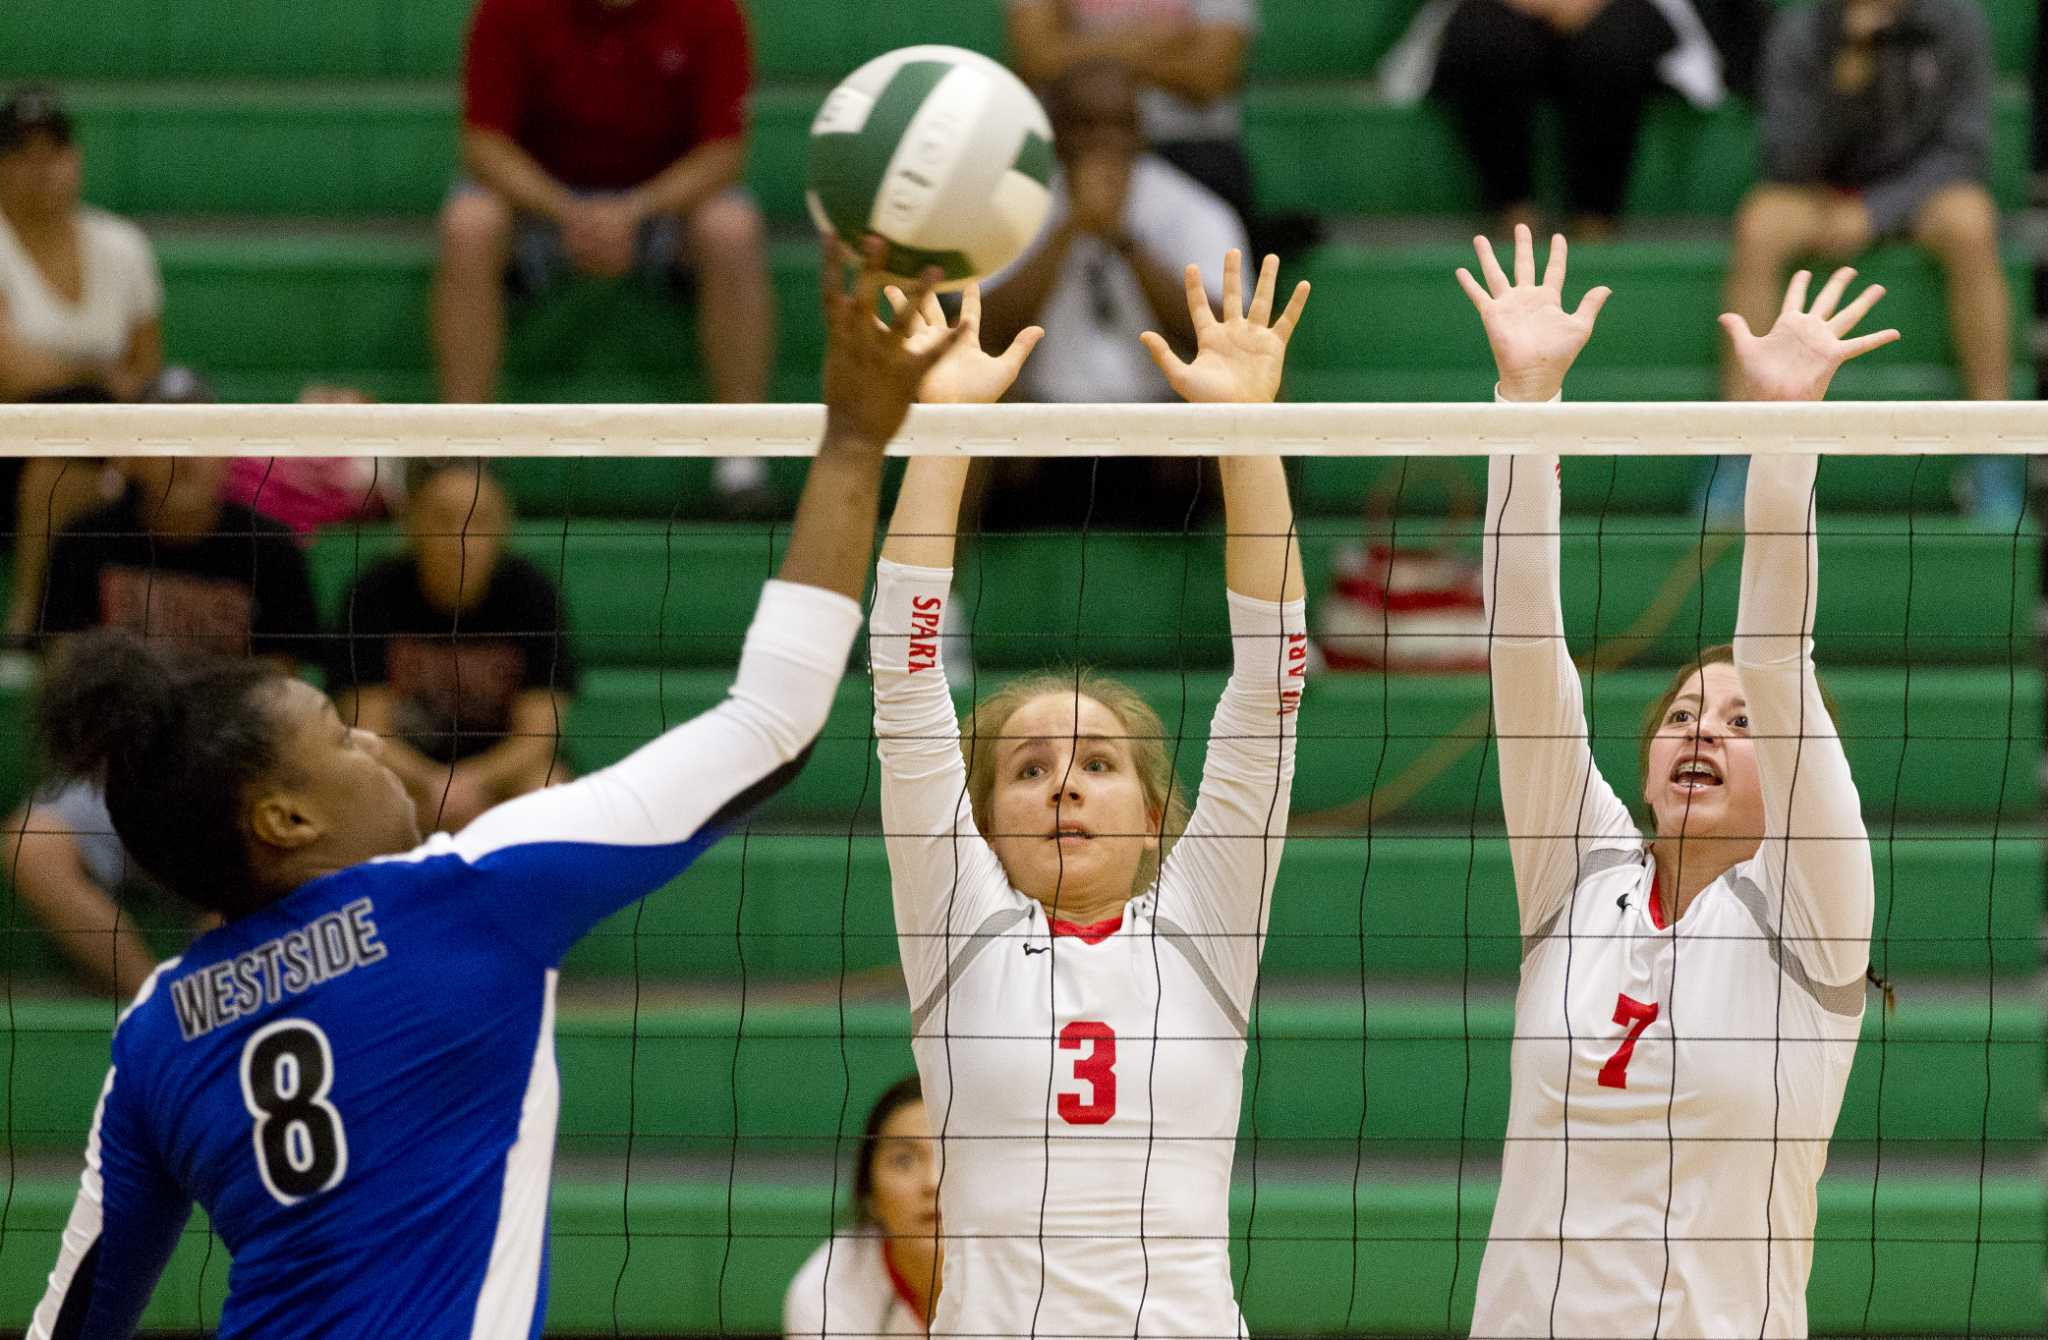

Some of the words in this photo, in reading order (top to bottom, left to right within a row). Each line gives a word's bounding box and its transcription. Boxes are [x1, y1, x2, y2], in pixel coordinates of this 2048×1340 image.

[171, 897, 388, 1040] WESTSIDE
[1057, 1020, 1117, 1125] 3
[1597, 993, 1660, 1089] 7
[240, 1019, 347, 1206] 8
